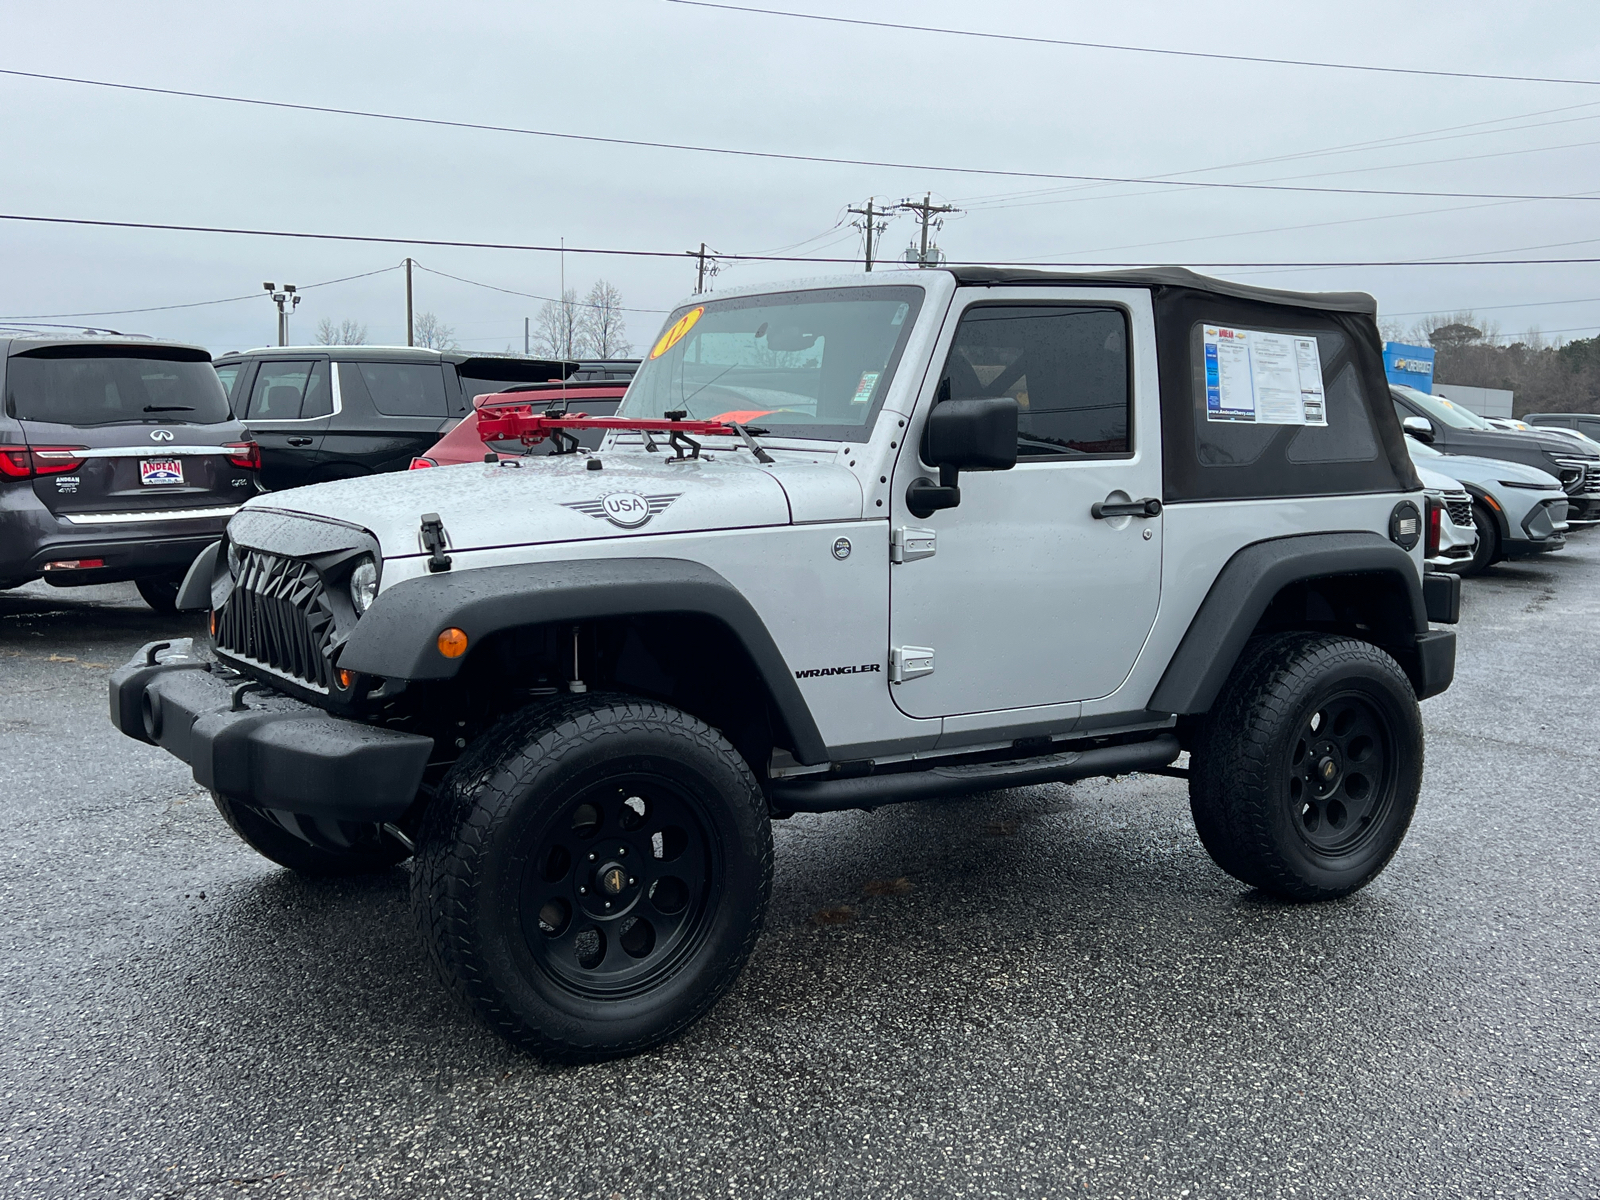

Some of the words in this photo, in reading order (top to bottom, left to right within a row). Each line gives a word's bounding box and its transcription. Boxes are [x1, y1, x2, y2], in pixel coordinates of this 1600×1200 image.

[142, 461, 181, 477] ANDEAN
[608, 497, 645, 513] USA
[794, 663, 881, 679] WRANGLER
